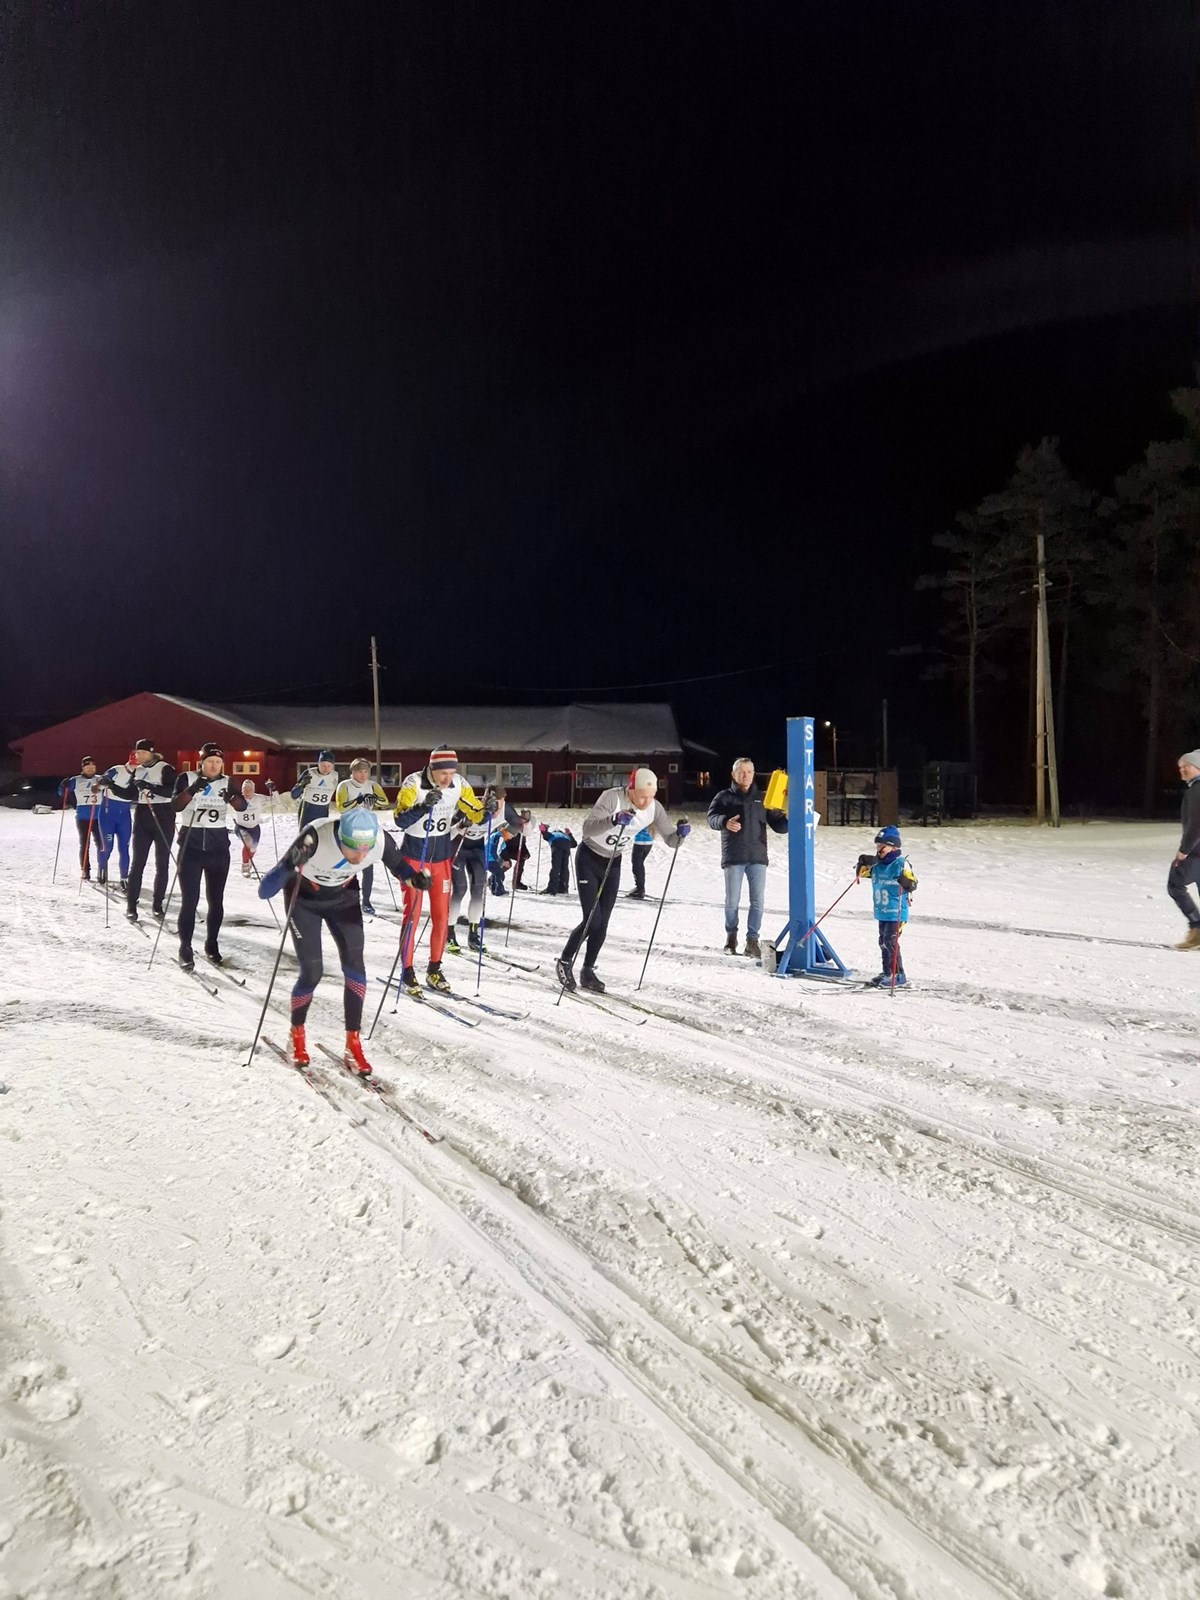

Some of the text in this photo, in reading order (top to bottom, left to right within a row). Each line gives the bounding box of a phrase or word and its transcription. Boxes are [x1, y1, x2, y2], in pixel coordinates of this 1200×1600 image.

[804, 724, 815, 839] START
[83, 795, 98, 804] 73
[311, 793, 328, 802] 58
[196, 808, 220, 823] 79
[242, 813, 256, 822] 81
[422, 817, 447, 833] 66
[605, 834, 631, 847] 62
